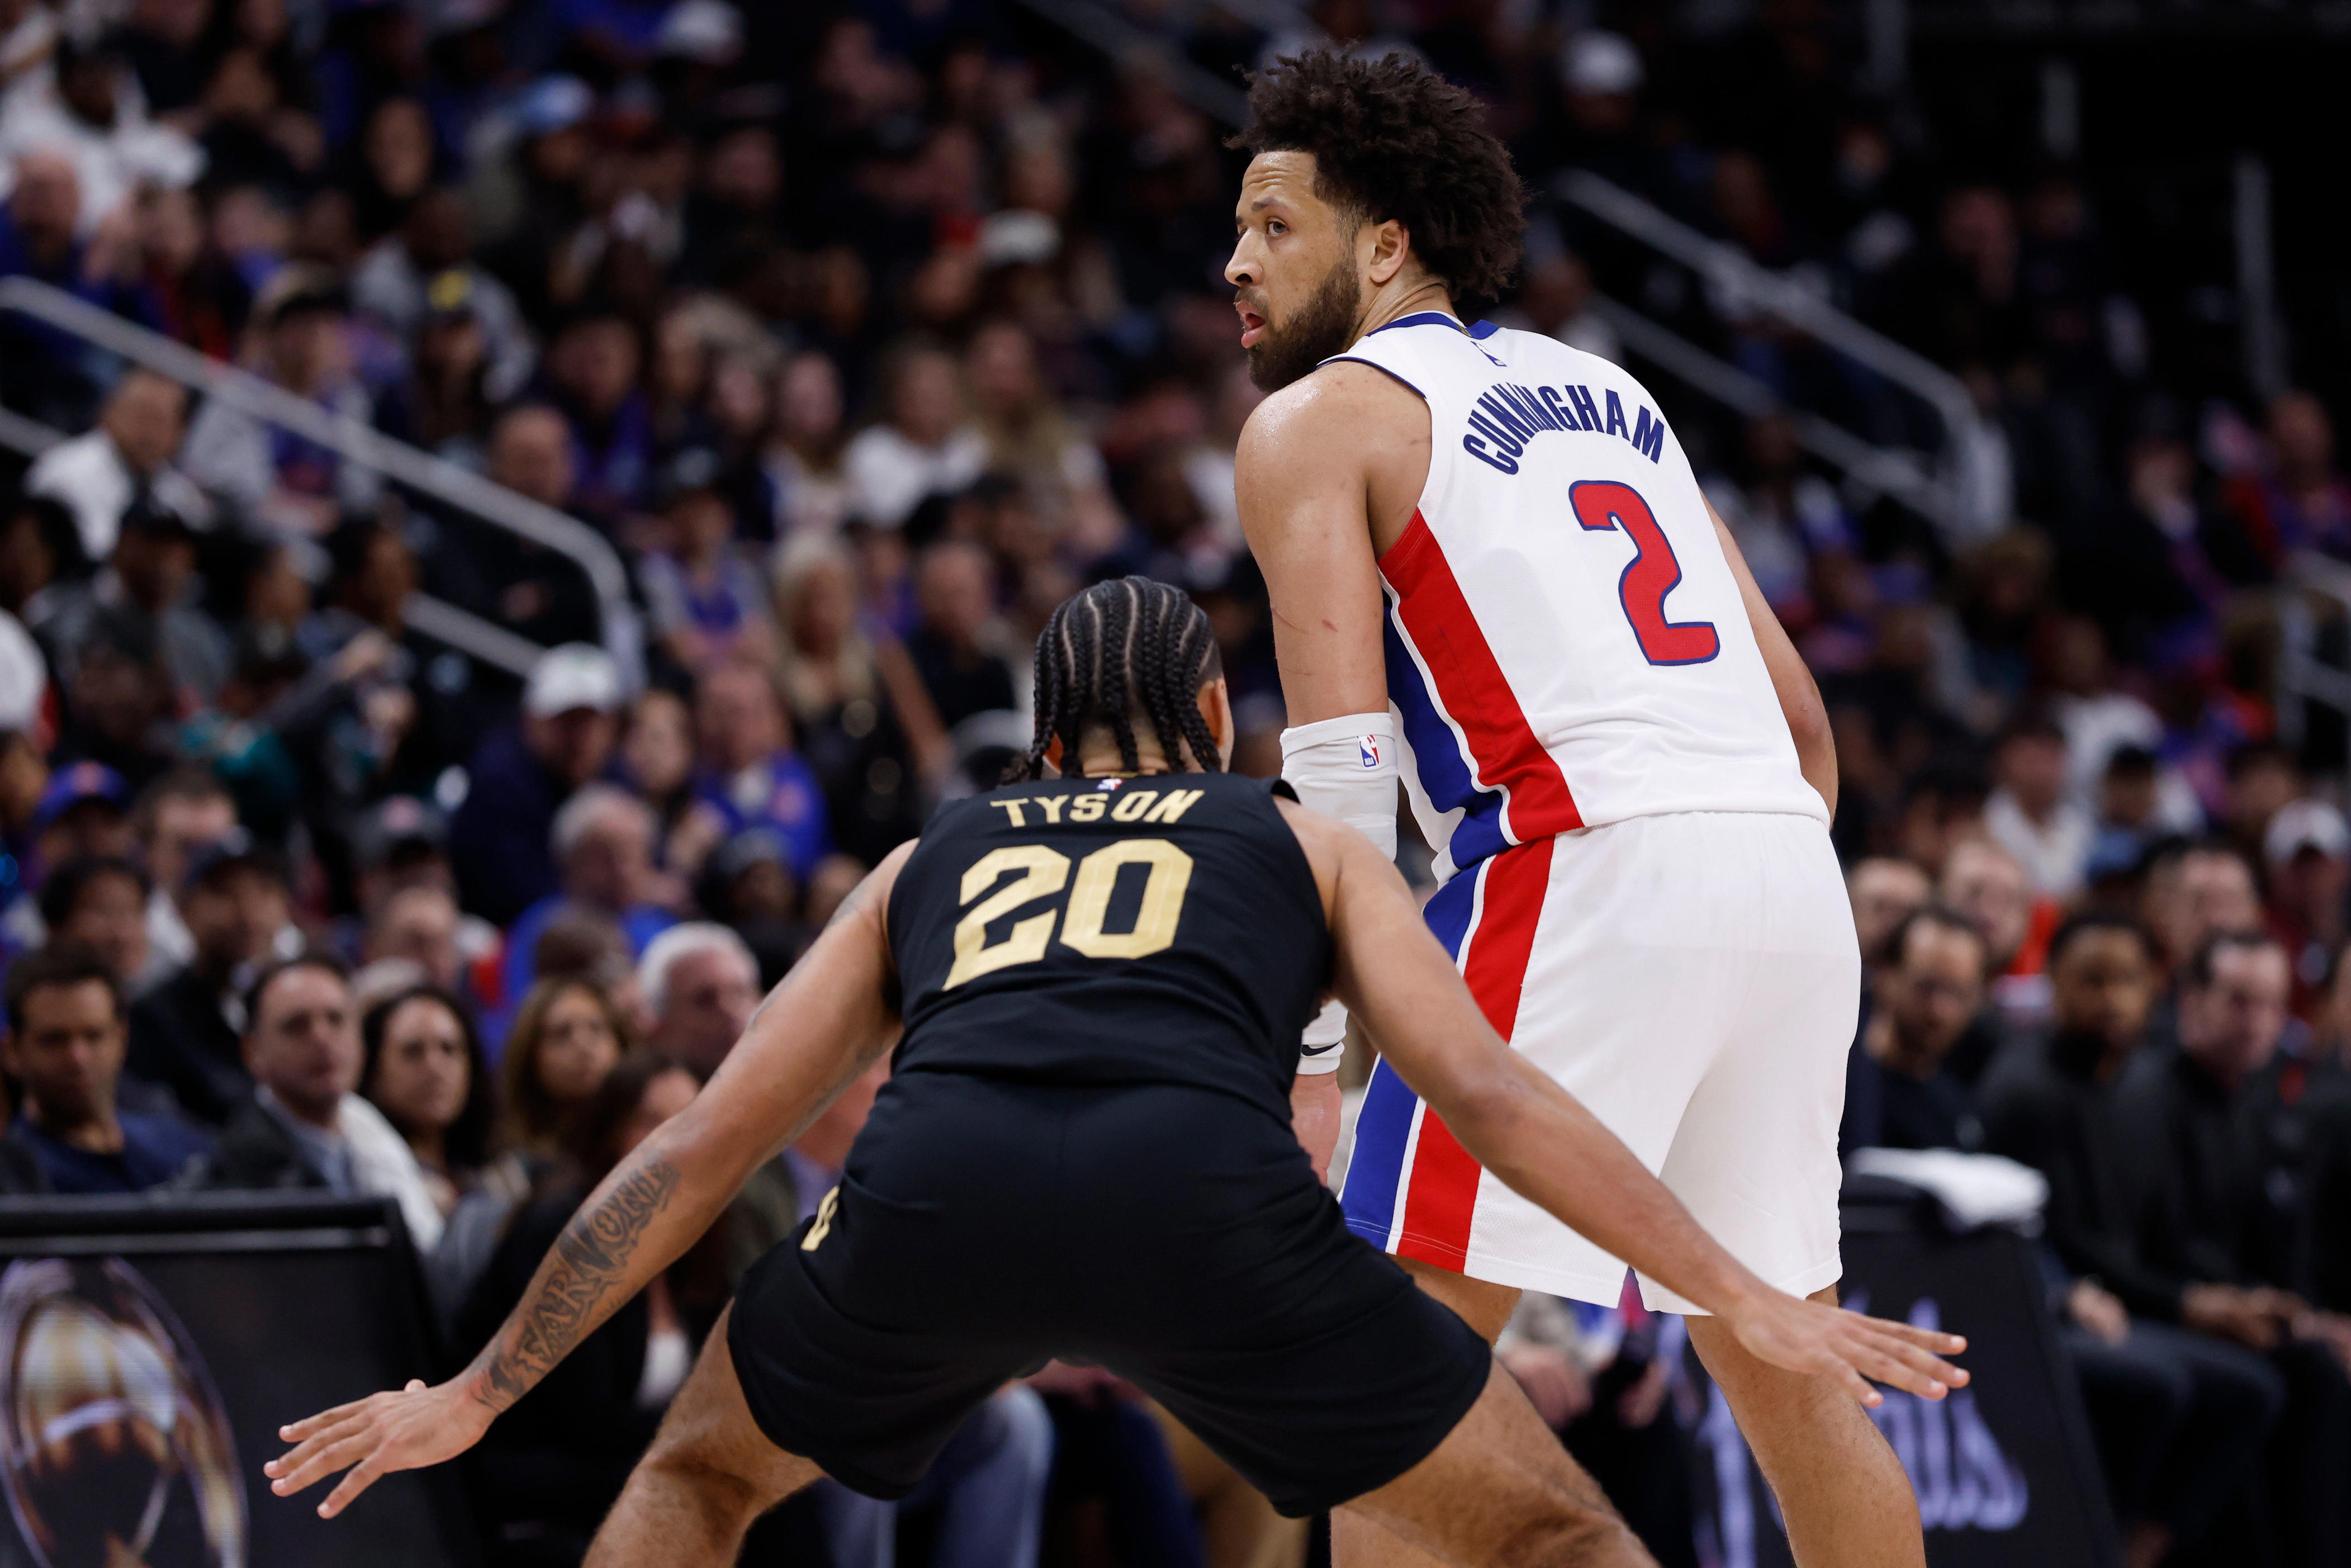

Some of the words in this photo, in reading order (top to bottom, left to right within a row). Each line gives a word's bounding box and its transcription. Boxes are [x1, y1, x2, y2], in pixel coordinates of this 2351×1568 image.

[1463, 382, 1664, 475] CUNNINGHAM
[1568, 480, 1720, 666] 2
[990, 789, 1205, 827] TYSON
[1364, 757, 1374, 766] NBA
[942, 839, 1194, 991] 20
